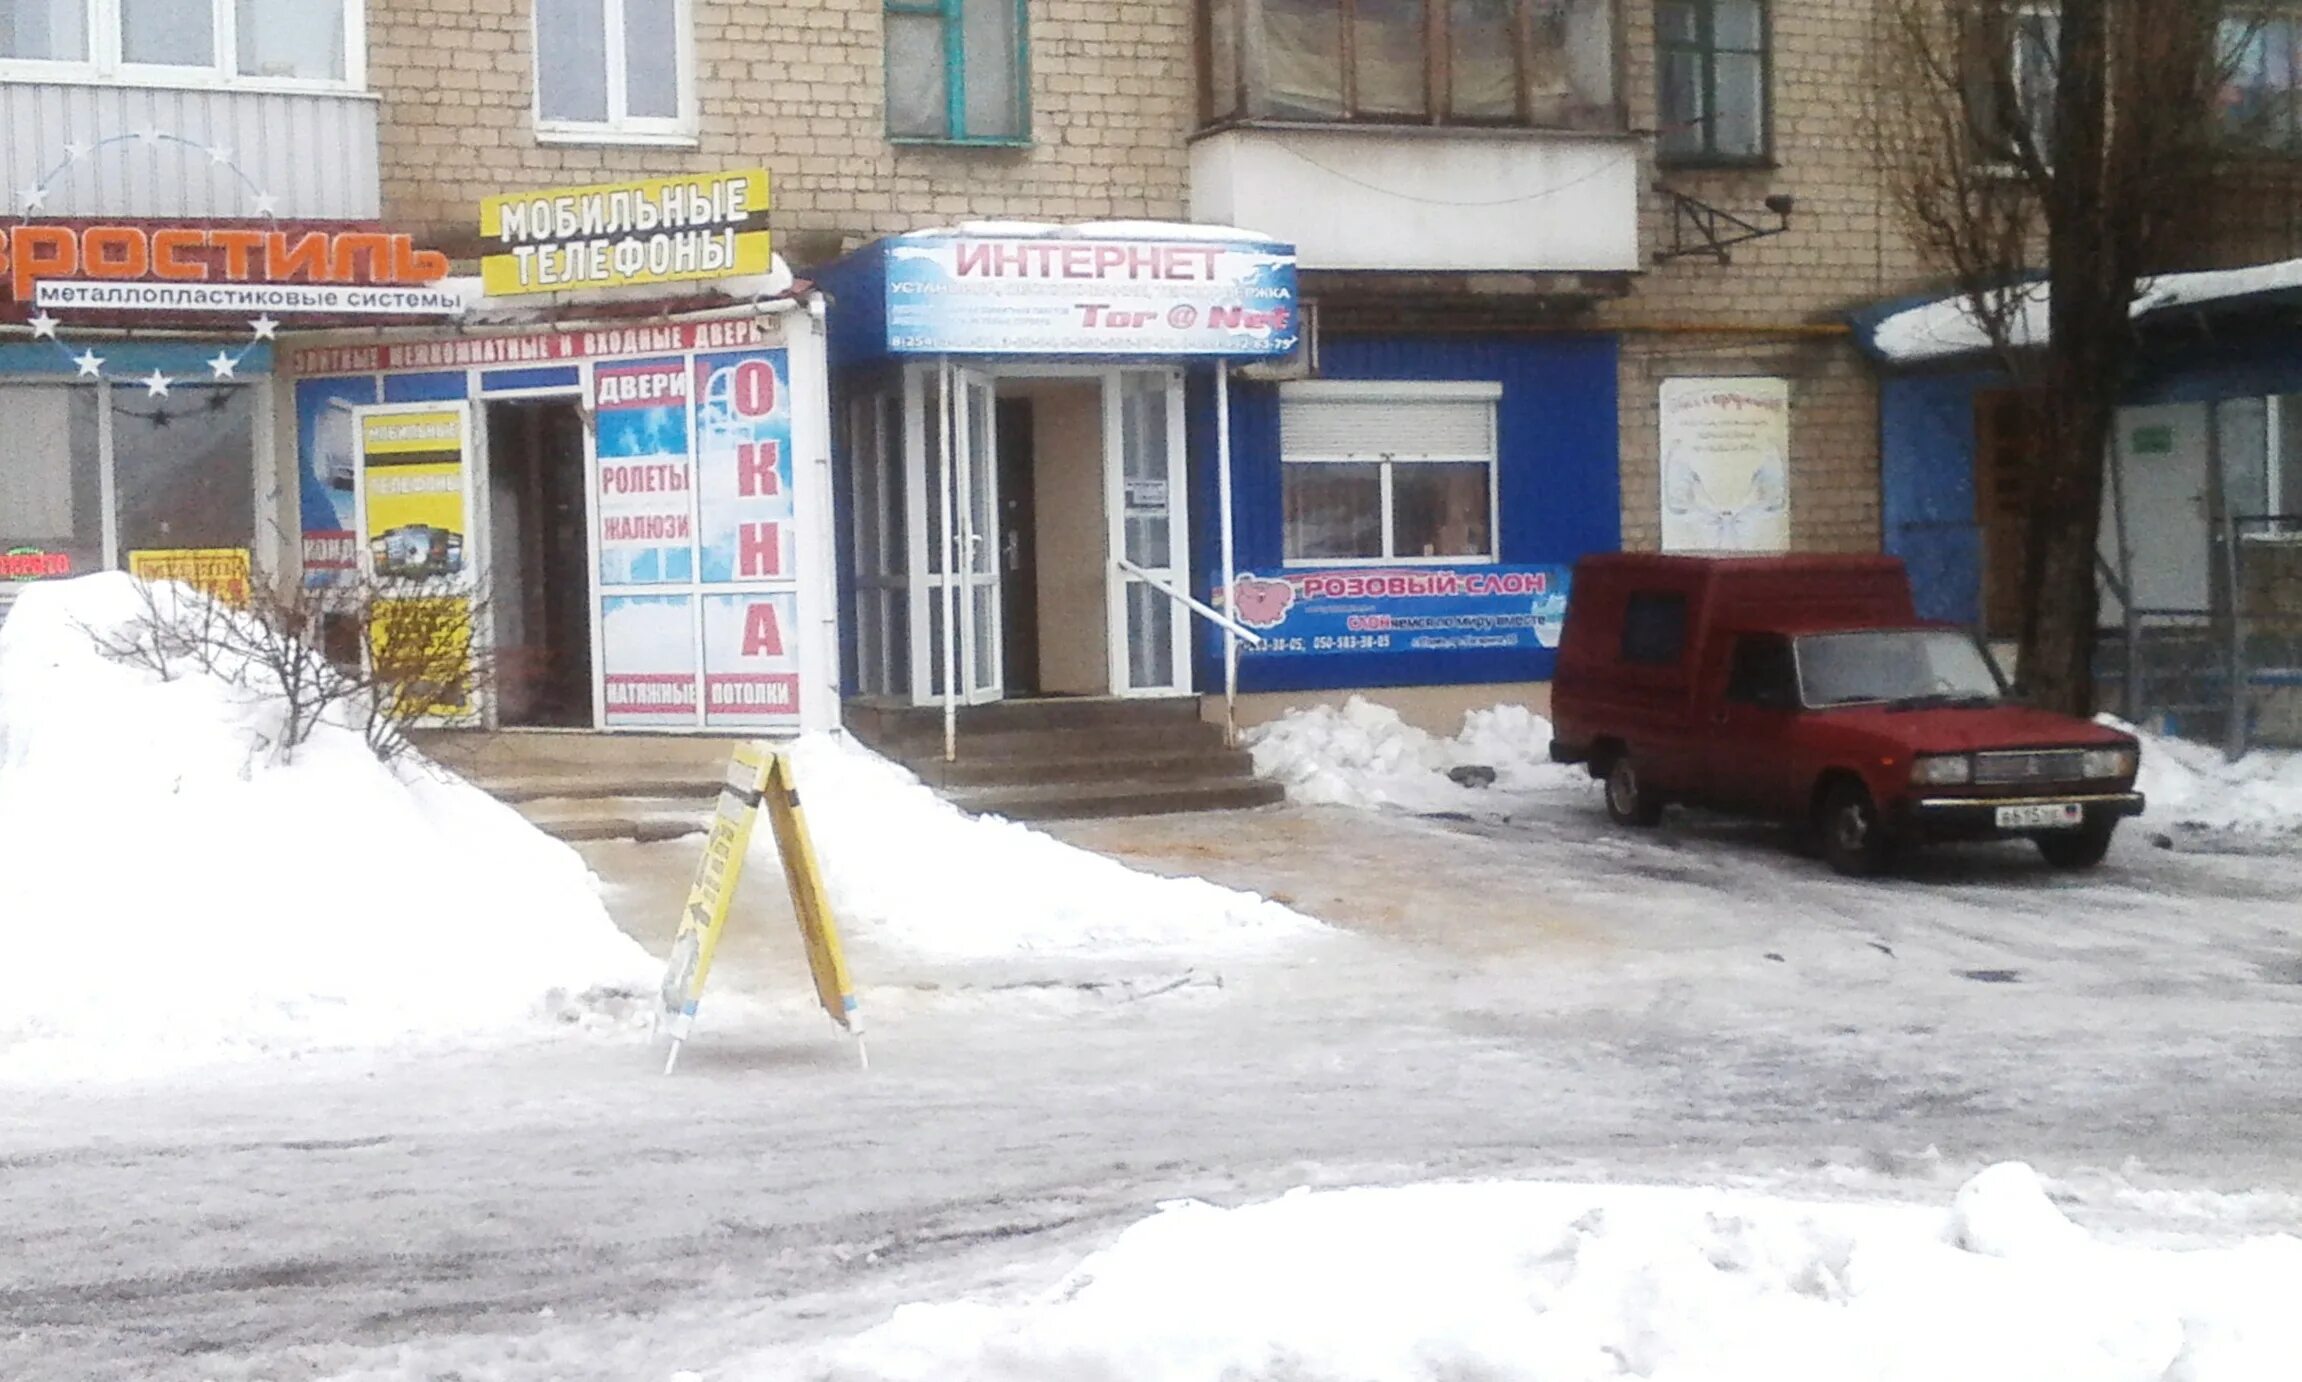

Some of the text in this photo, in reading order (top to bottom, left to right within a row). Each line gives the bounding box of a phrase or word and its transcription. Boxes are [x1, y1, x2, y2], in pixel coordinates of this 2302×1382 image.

[501, 179, 748, 242] МОБИЛЬНЫЕ
[0, 226, 449, 301] РОСТИЛЬ
[512, 228, 735, 285] ТЕЛЕФОНЫ
[956, 243, 1225, 280] ИНТЕРНЕТ
[41, 283, 461, 310] металлопластиковые системы
[1075, 303, 1159, 328] Tor
[583, 325, 683, 355] ВХОДНЫЕ
[599, 373, 686, 406] ДВЕРИ
[602, 462, 690, 495] РОЛЕТЫ
[734, 358, 784, 656] ОКНА
[604, 514, 690, 541] ЖАЛЮЗИ
[1303, 571, 1546, 598] РОЗОВЫЙ СЛОН
[607, 682, 790, 705] НАТЯЖНЫЕ ПОТОЛКИ
